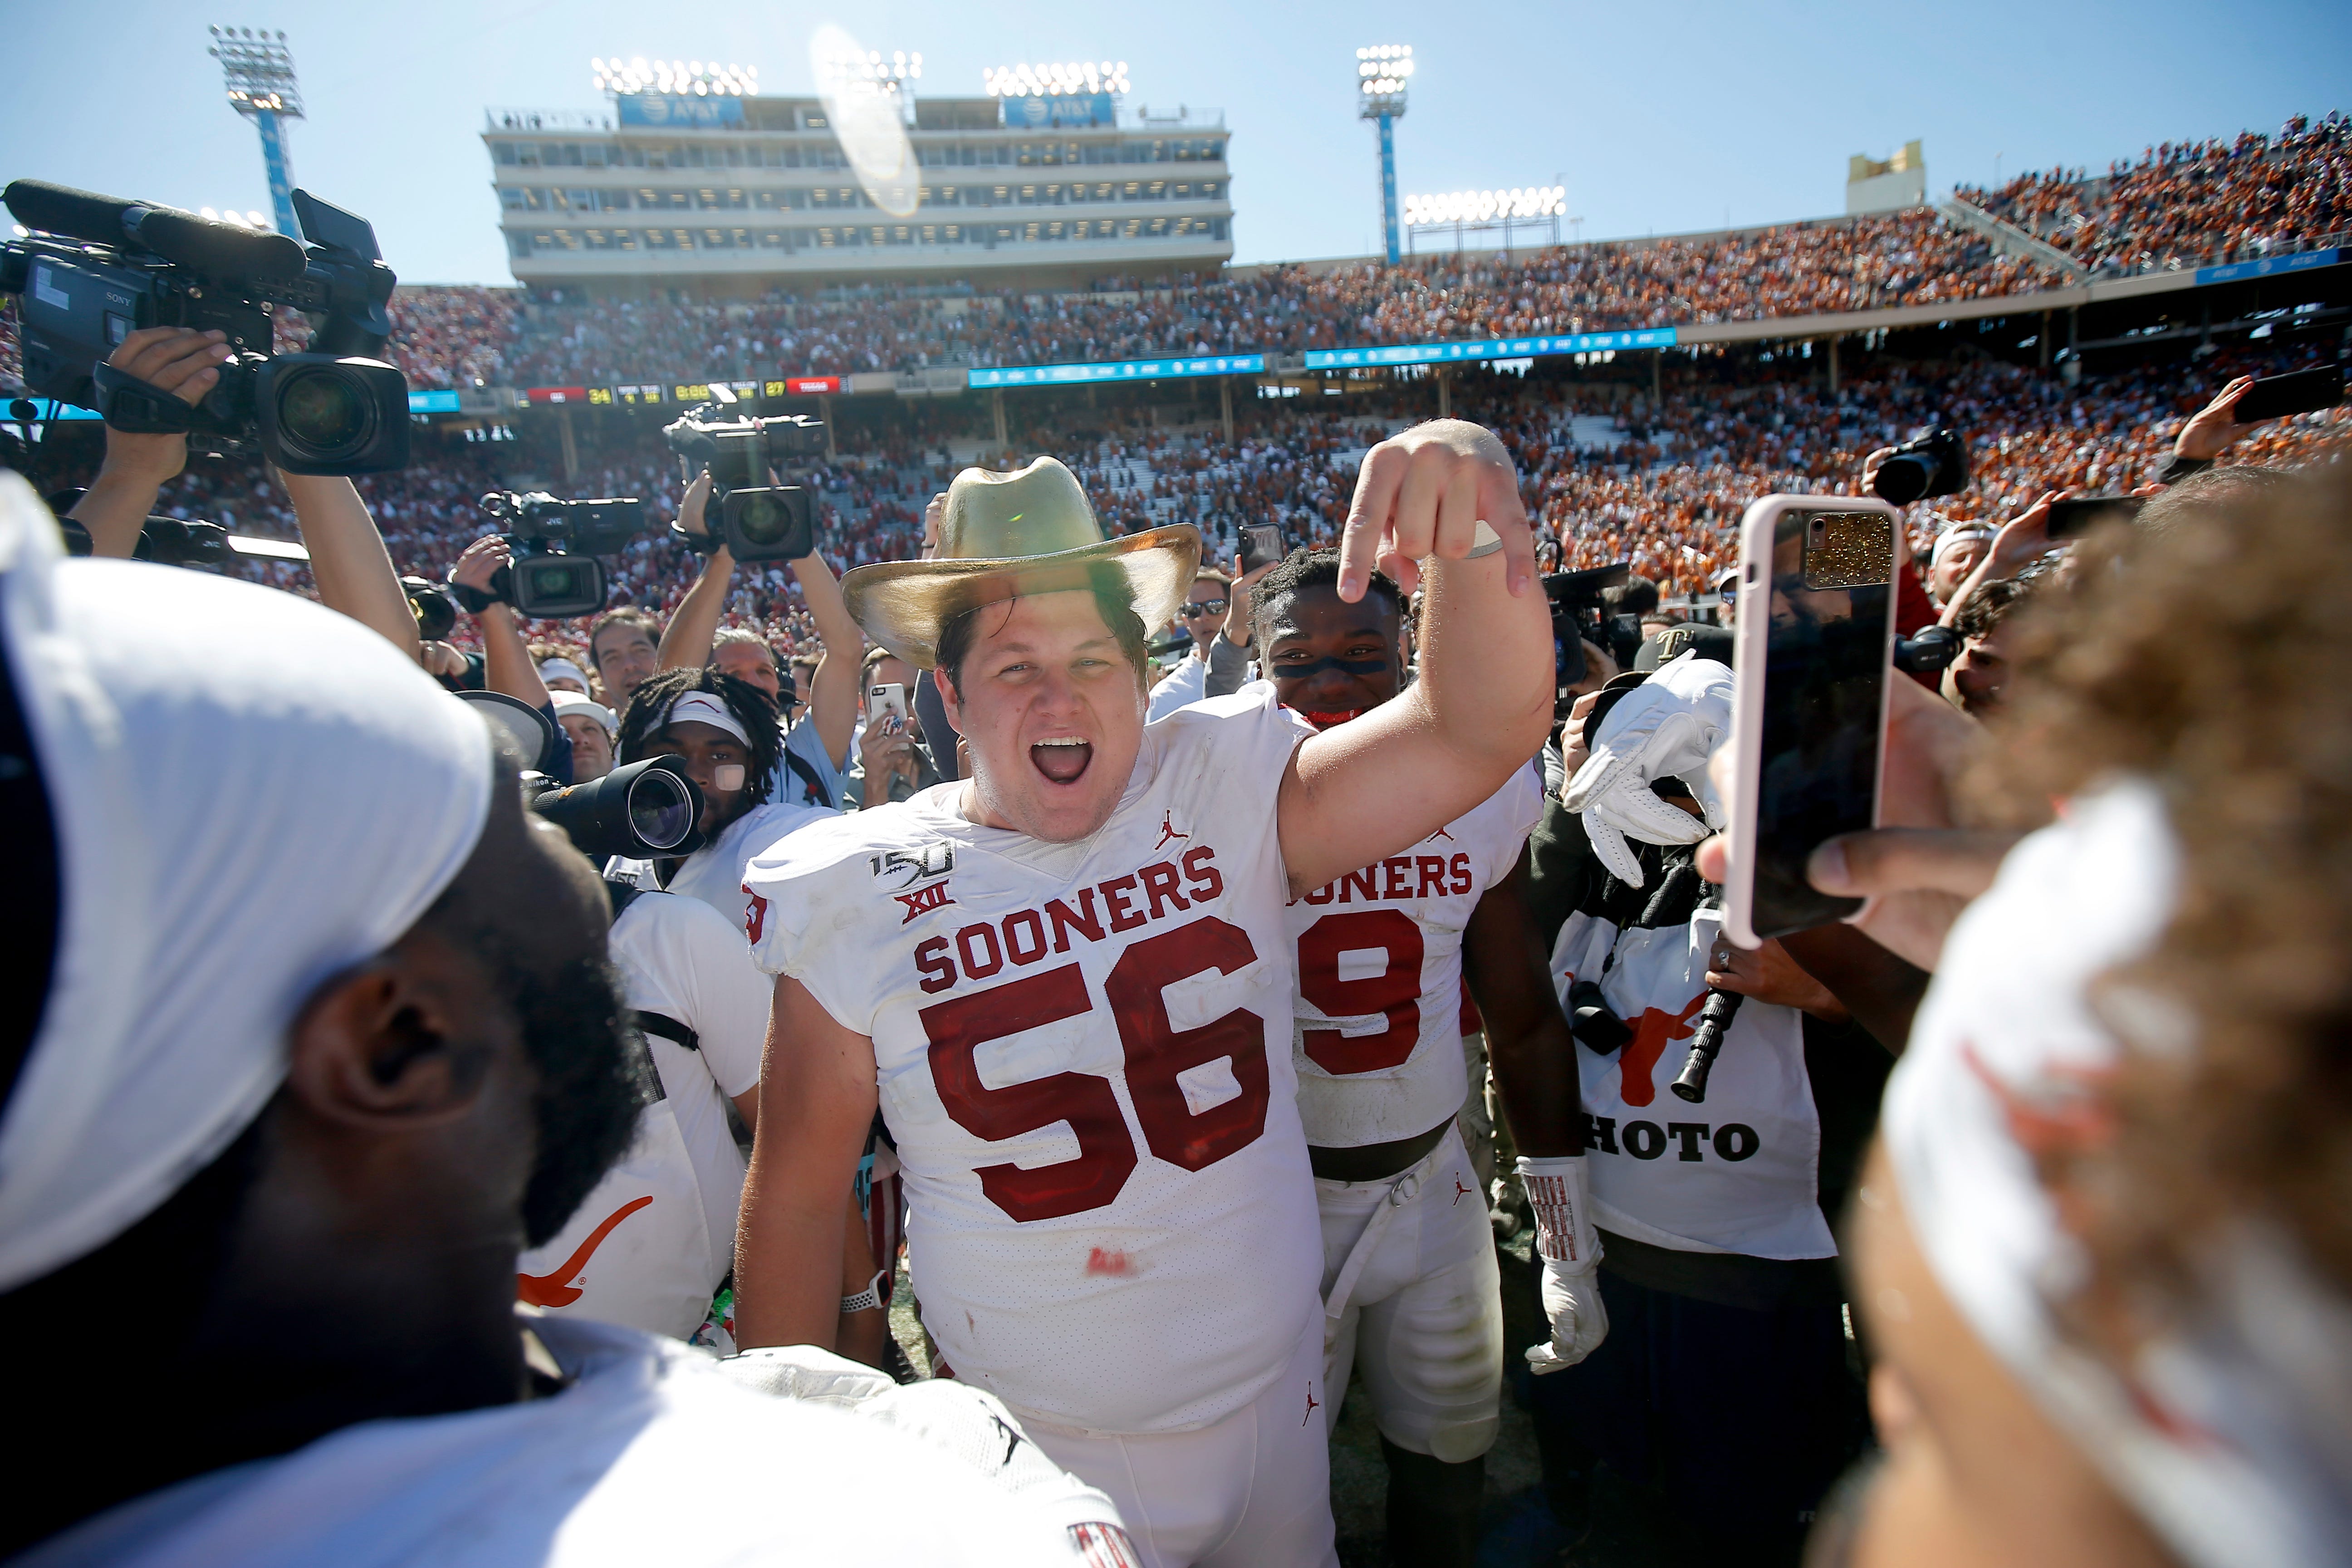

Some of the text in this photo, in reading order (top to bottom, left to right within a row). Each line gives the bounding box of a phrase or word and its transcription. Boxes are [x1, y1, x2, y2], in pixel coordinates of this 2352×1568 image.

[674, 101, 719, 120] AT&T
[106, 292, 131, 306] SONY
[589, 388, 612, 404] 34
[765, 381, 785, 397] 27
[1656, 629, 1694, 663] T
[527, 779, 549, 788] Nikon
[869, 840, 954, 890] 150
[894, 878, 956, 925] XII
[914, 845, 1223, 994] SOONERS
[1297, 908, 1424, 1076] 9
[918, 915, 1270, 1223] 56
[1582, 1112, 1760, 1162] HOTO
